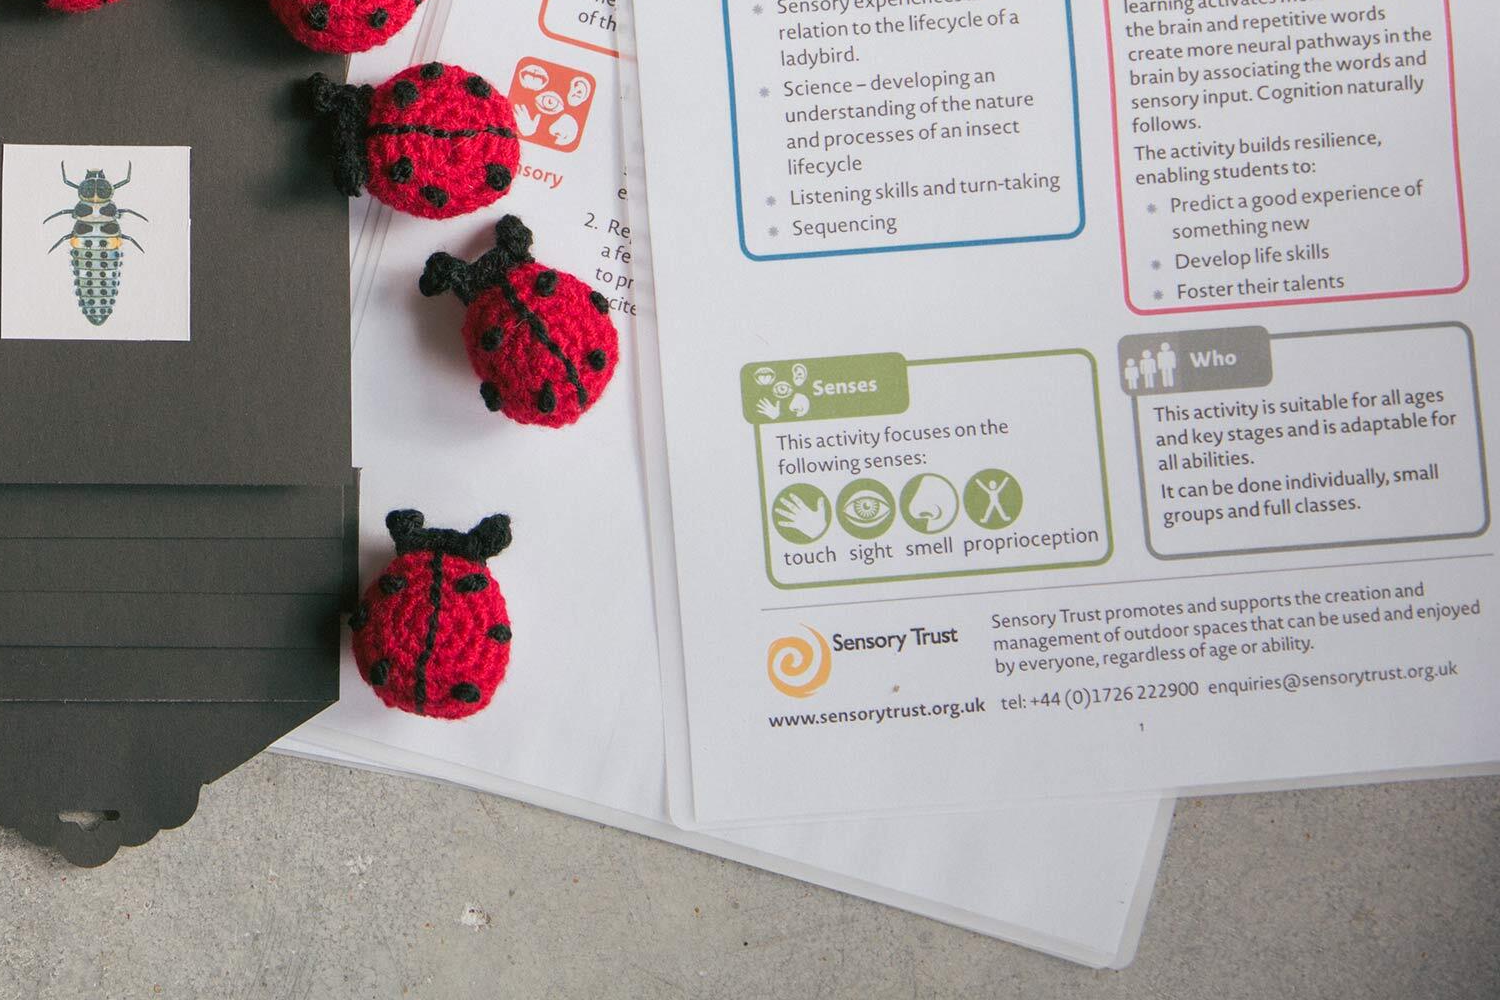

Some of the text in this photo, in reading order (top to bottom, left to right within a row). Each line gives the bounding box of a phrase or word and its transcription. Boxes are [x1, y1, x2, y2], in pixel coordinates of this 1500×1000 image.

[578, 11, 599, 25] of
[779, 8, 1019, 40] relation to the lifecycle of a
[781, 45, 859, 70] ladybird.
[784, 80, 852, 97] Science
[871, 70, 970, 91] developing
[974, 71, 995, 84] an
[1133, 132, 1382, 161] The activity builds resilience,
[1136, 162, 1316, 186] enabling students to:
[790, 173, 1060, 206] Listening skills and turn-taking
[584, 212, 598, 230] 2.
[792, 215, 897, 239] Sequencing
[601, 246, 610, 258] a
[1175, 243, 1329, 270] Develop life skills
[595, 268, 612, 283] to
[1177, 274, 1344, 299] Foster their talents
[1190, 349, 1237, 368] Who
[812, 380, 877, 396] Senses
[1153, 389, 1444, 422] This activity is suitable for all ages
[776, 419, 1008, 451] This activity focuses on the
[778, 453, 927, 475] following senses:
[1161, 463, 1438, 499] It can be done individually, small
[784, 528, 1098, 566] touch sight smell proprioception
[992, 581, 1424, 629] Sensory Trust promotes and supports the creation and
[833, 627, 958, 652] Sensory Trust
[1208, 661, 1458, 696] enquiries@sensorytrust.org.uk
[1001, 694, 1026, 710] tel:
[1030, 692, 1061, 707] +44
[1137, 681, 1199, 700] 222900
[768, 697, 985, 727] www.sensorytrust.org.uk
